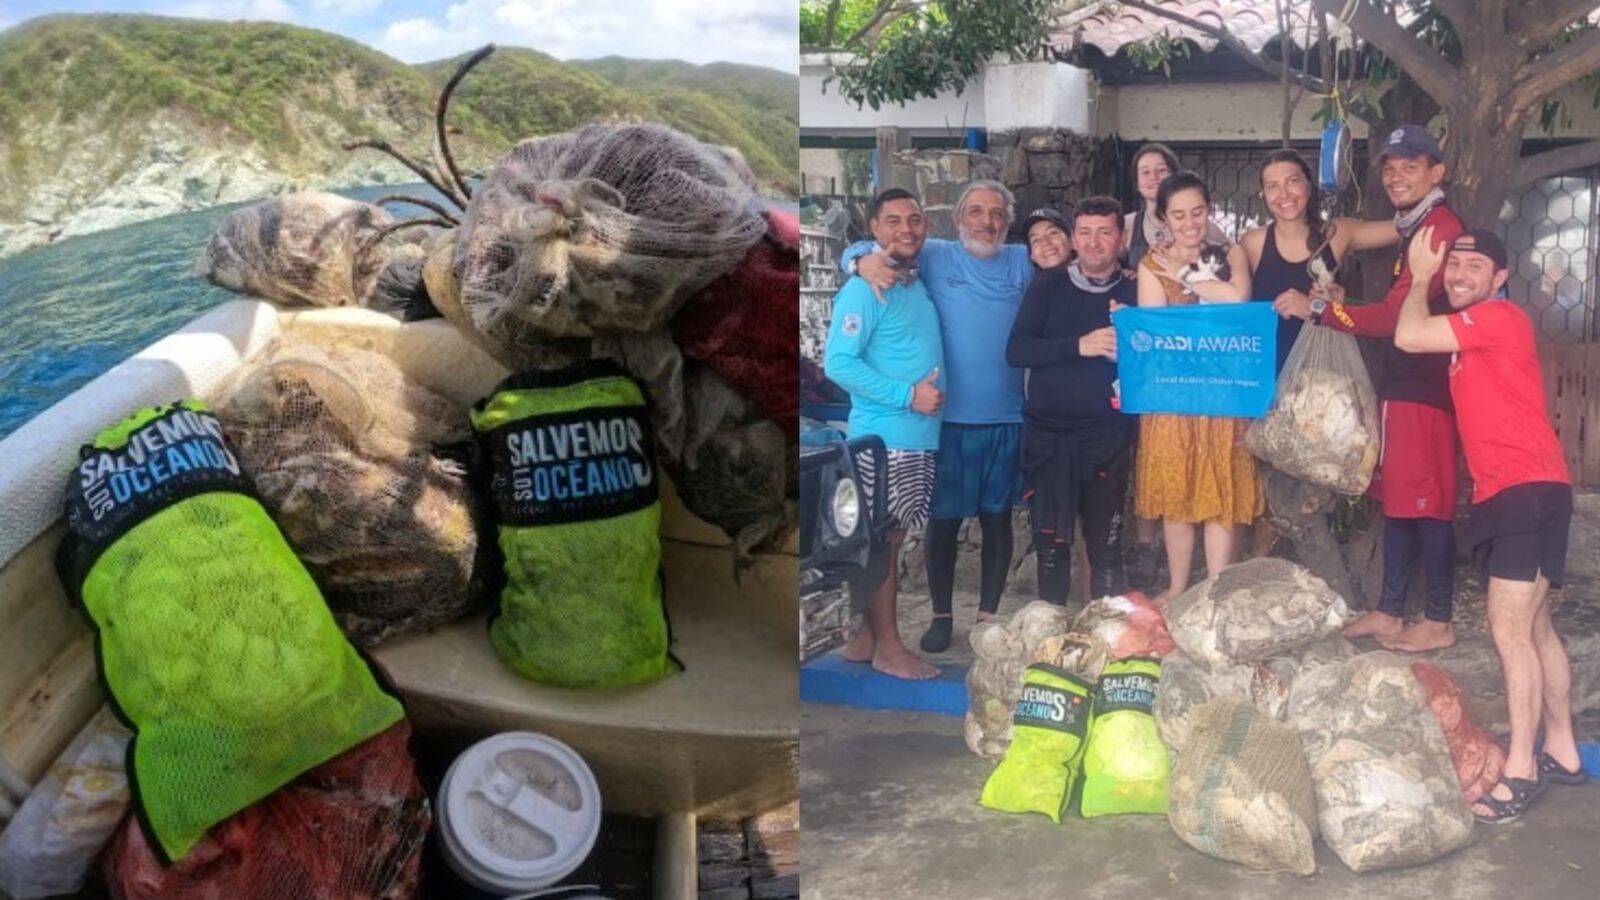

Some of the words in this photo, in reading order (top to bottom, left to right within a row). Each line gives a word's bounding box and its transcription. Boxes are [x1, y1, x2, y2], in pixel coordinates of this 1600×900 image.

[1154, 336, 1192, 351] PADI
[1197, 336, 1262, 352] AWARE
[507, 417, 652, 487] SALVEMOS
[84, 479, 115, 521] LOS
[512, 467, 534, 501] LOS
